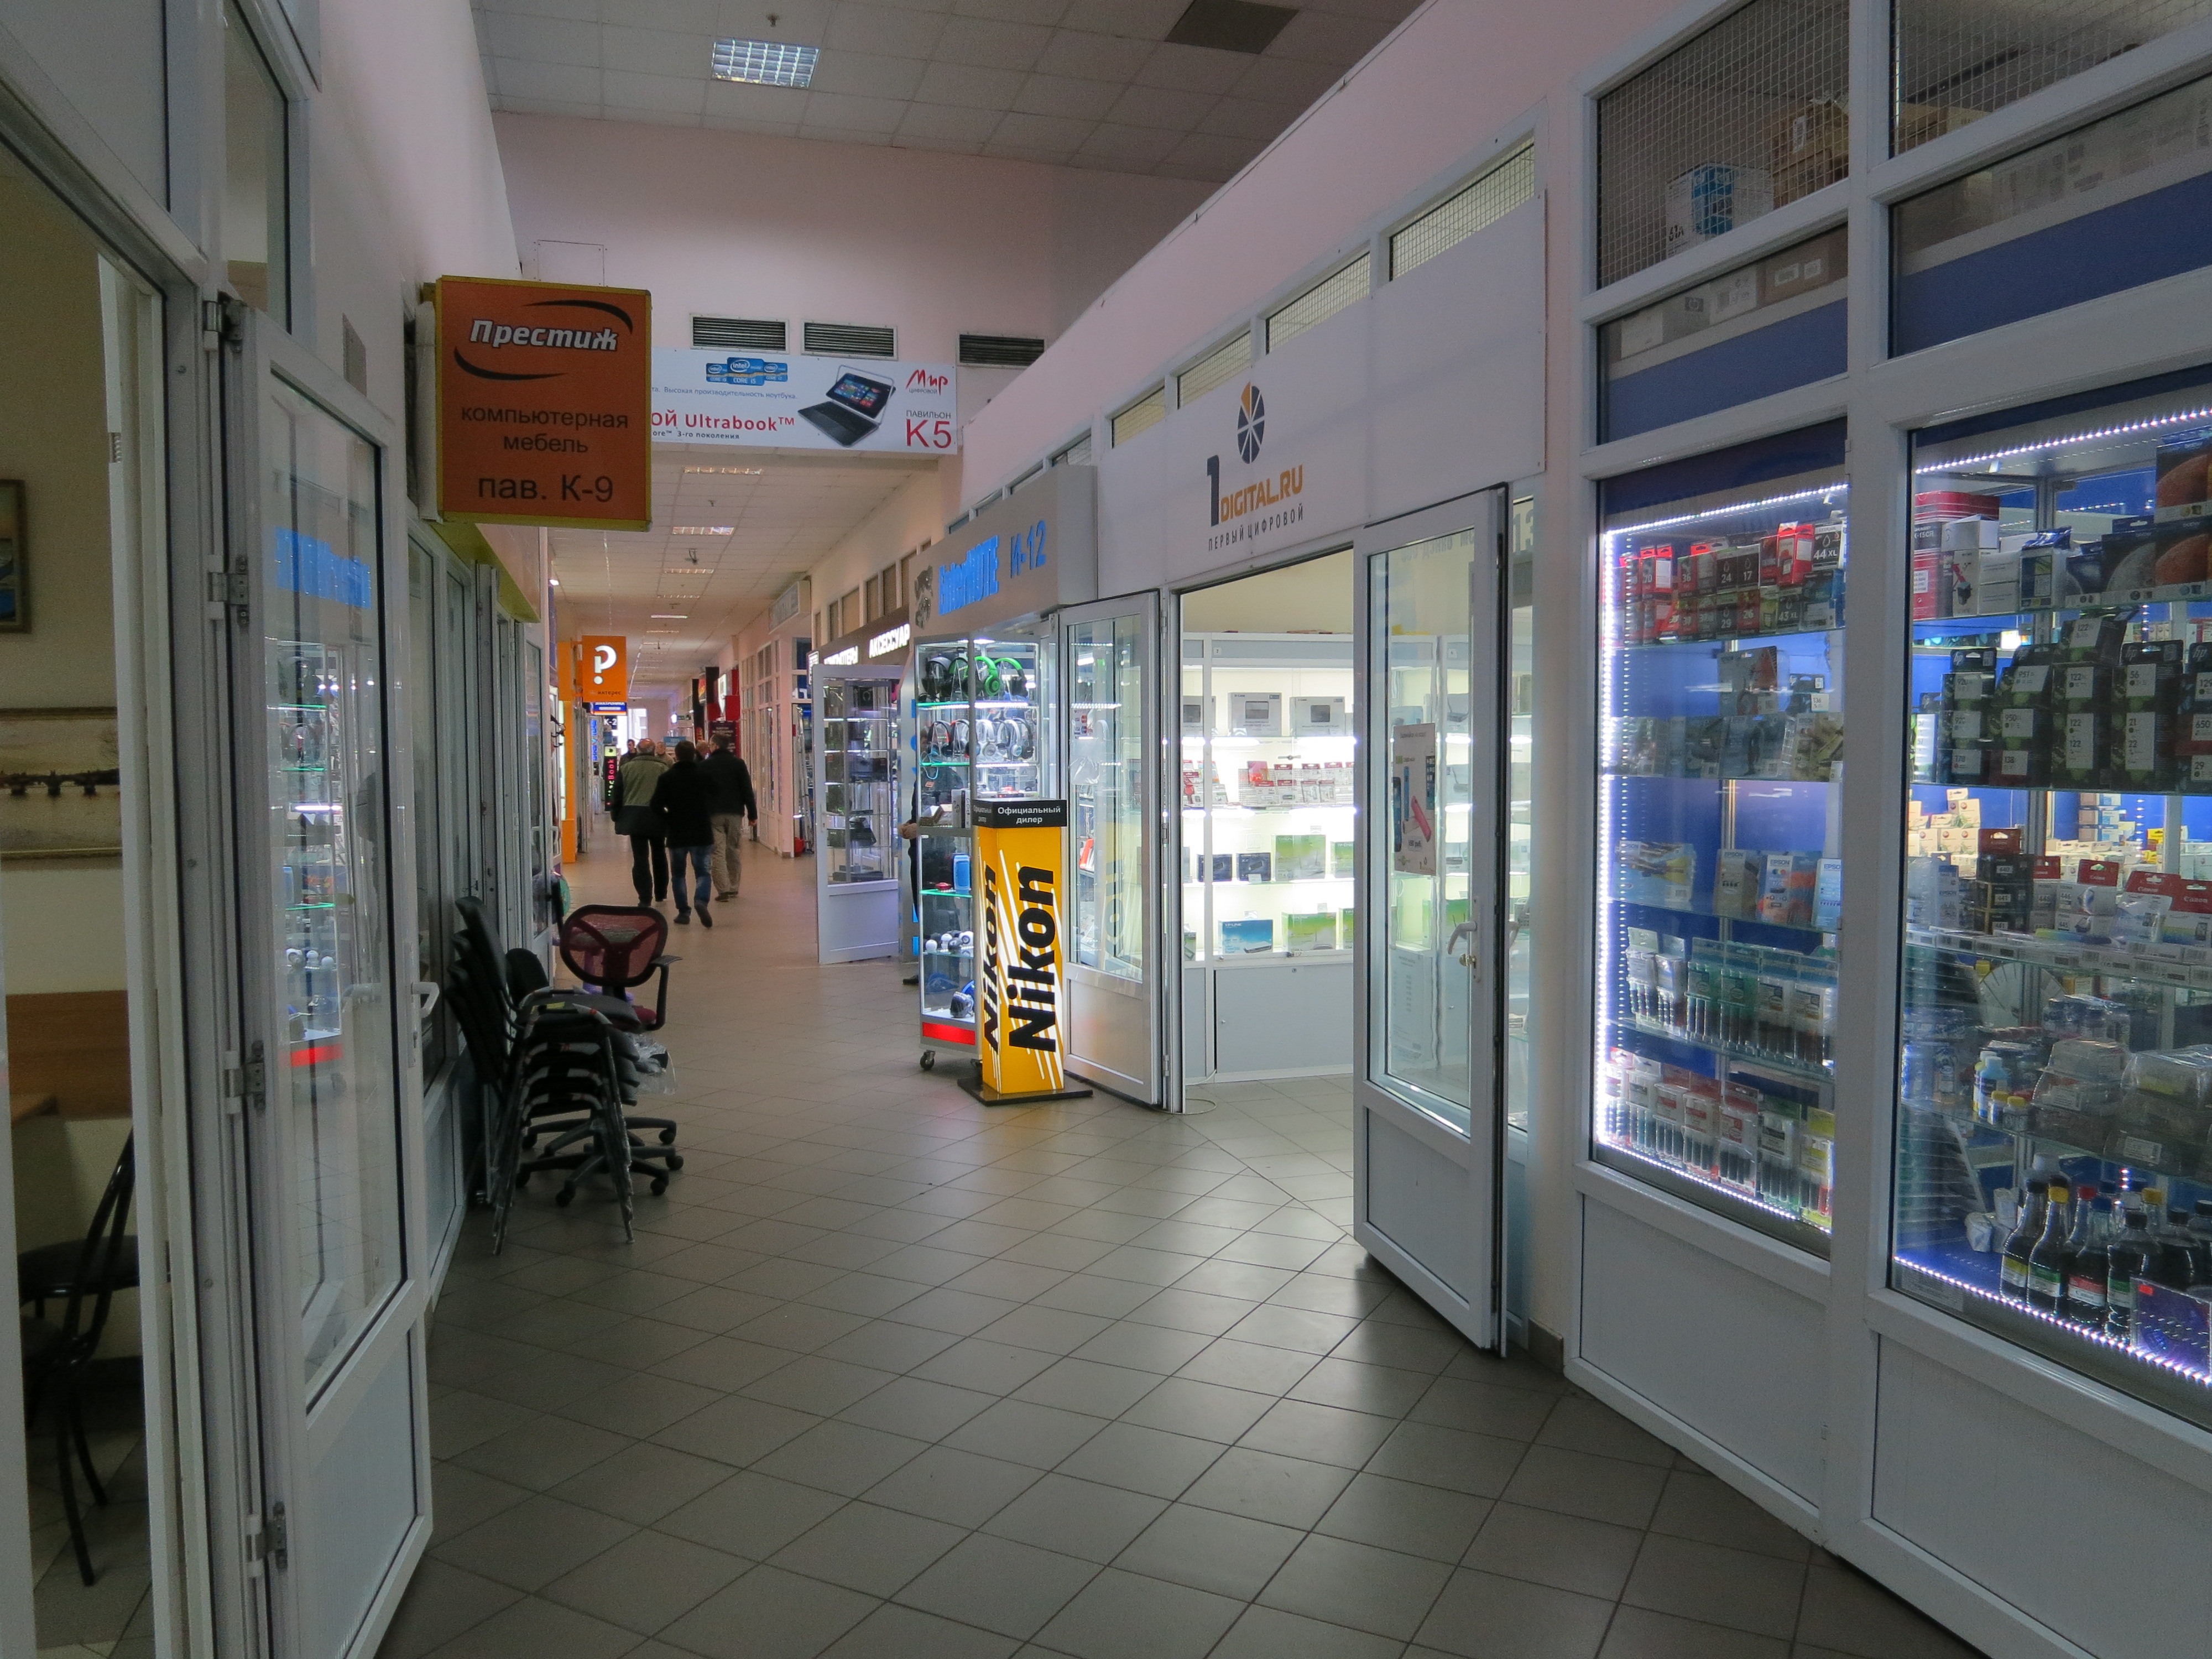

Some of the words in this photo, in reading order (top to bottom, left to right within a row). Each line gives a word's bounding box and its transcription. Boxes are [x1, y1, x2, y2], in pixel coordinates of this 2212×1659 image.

[469, 319, 618, 352] Престиж
[906, 369, 949, 396] Мир
[695, 389, 765, 399] производительность
[765, 392, 798, 400] ноутбука.
[461, 405, 629, 432] компьютерная
[906, 410, 952, 419] ПАВИЛЬОН
[503, 434, 589, 453] мебель
[478, 476, 546, 500] пав.
[561, 474, 614, 503] К-9
[1208, 525, 1244, 552] ПЕРВЫЙ
[1247, 503, 1303, 541] ЦИФРОВОЙ
[1813, 549, 1827, 560] 44
[1828, 548, 1838, 556] XL
[1682, 573, 1691, 582] 36
[1721, 574, 1732, 583] 24
[1743, 570, 1752, 581] 17
[1778, 612, 1789, 622] 43
[1721, 618, 1731, 628] 29
[2193, 646, 2207, 660] hp
[2005, 714, 2016, 722] 950
[2195, 721, 2210, 729] 650
[2194, 761, 2204, 770] 29
[997, 806, 1061, 816] Официальный
[1016, 816, 1043, 825] дилер
[2183, 895, 2208, 904] Canon
[982, 863, 1000, 1053] Nikon
[1006, 865, 1057, 1053] Nikon
